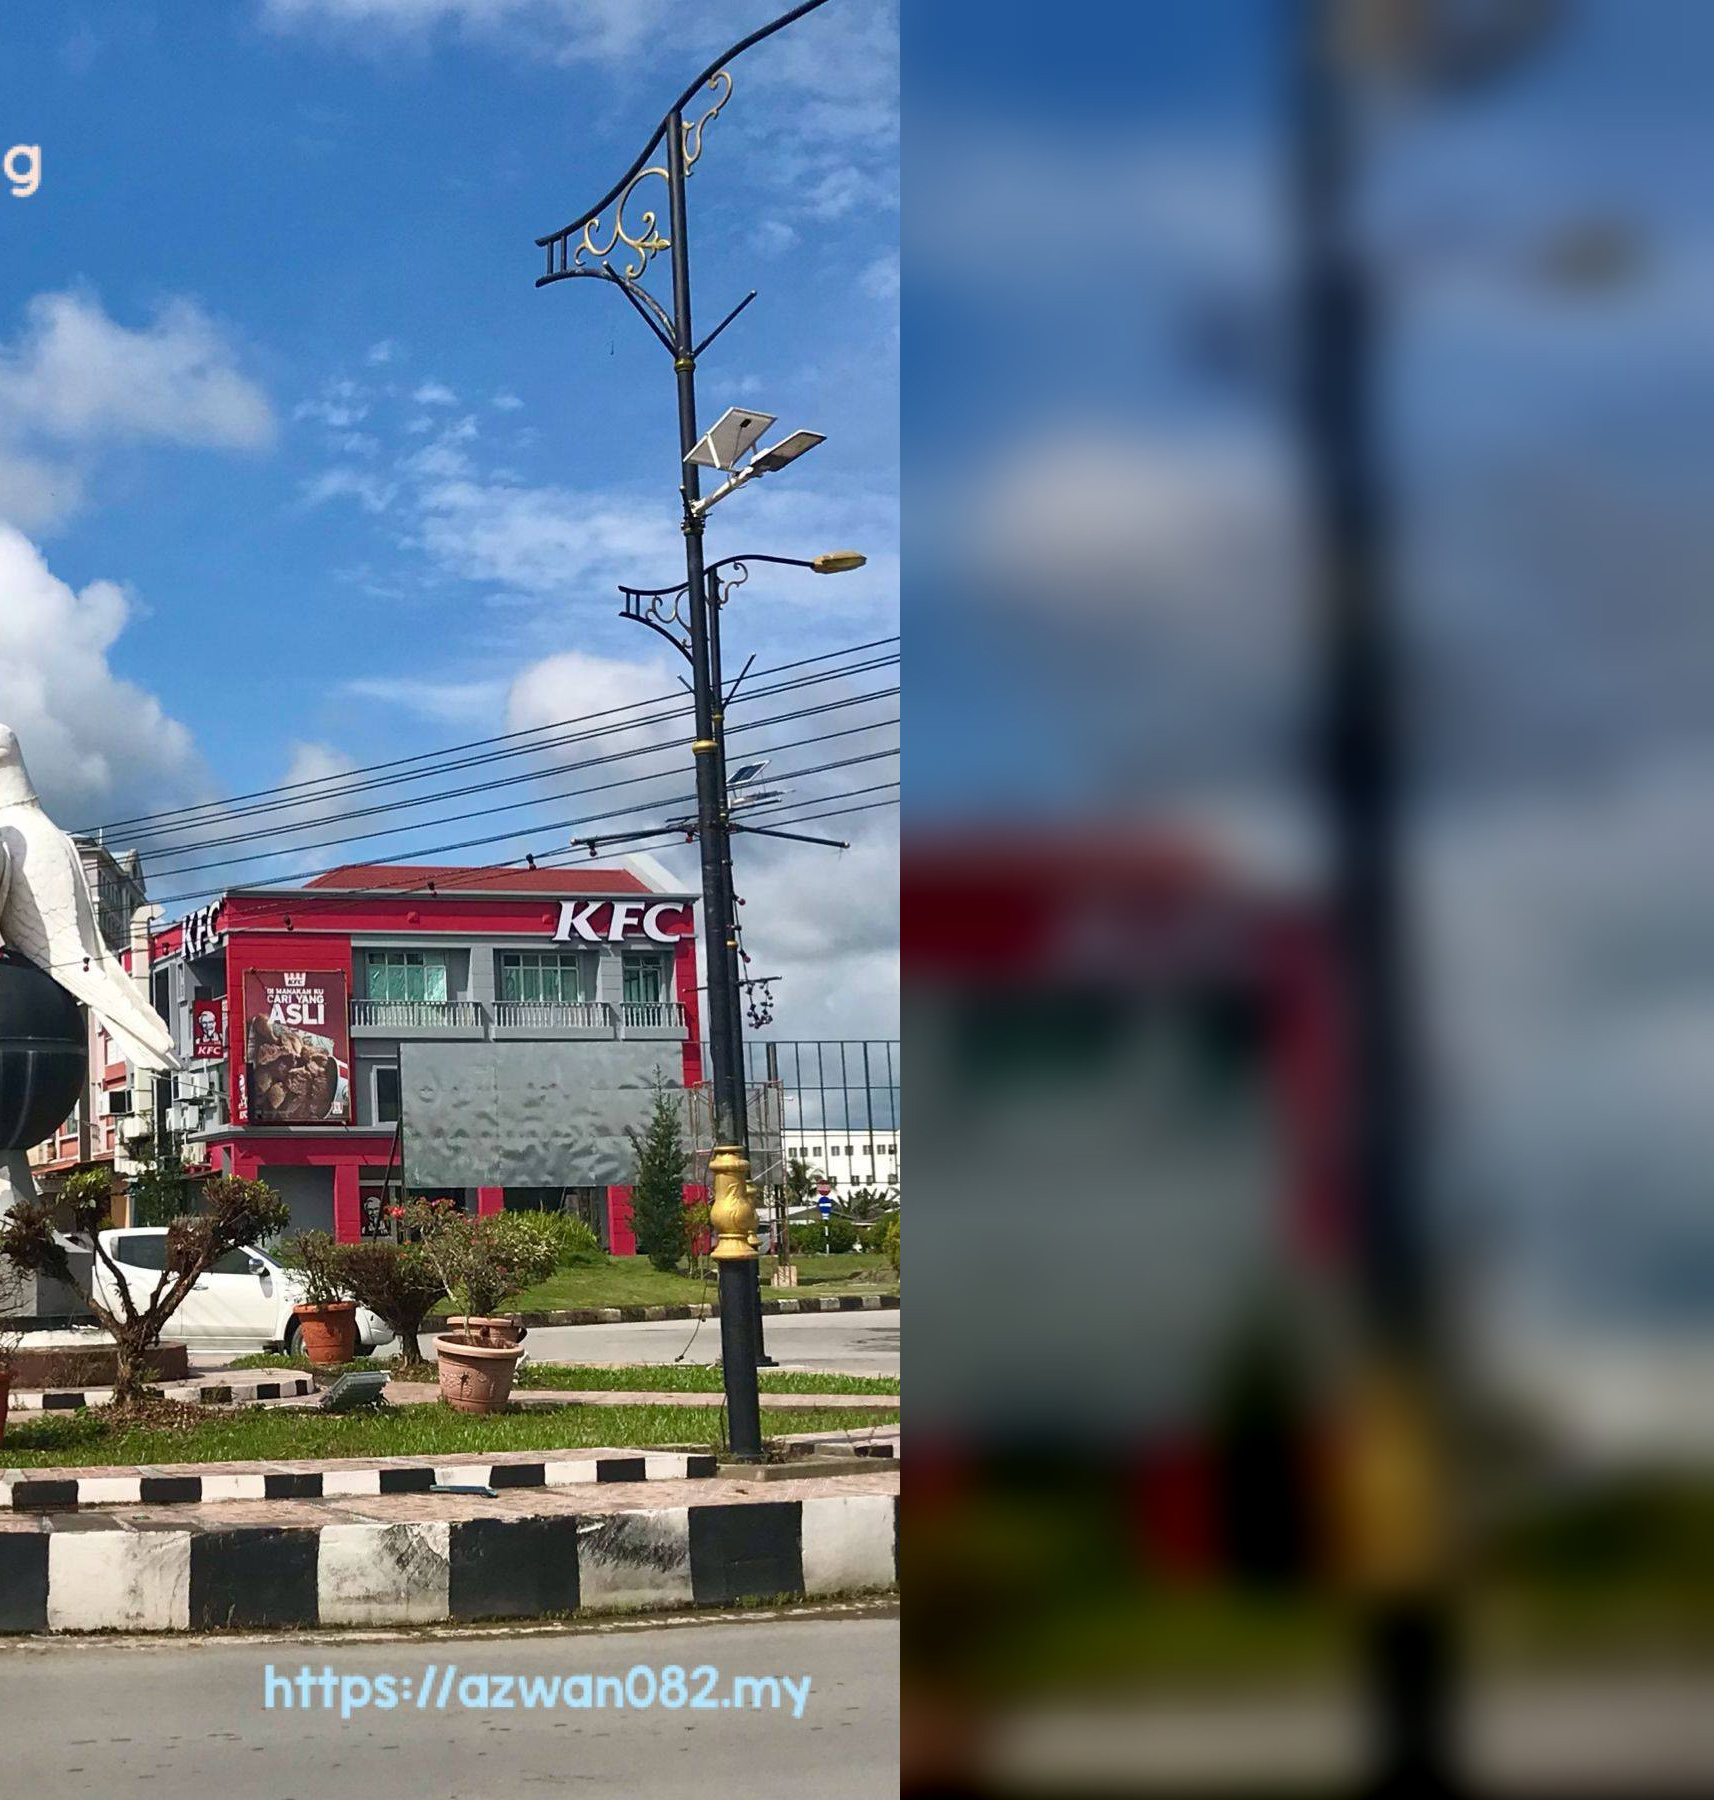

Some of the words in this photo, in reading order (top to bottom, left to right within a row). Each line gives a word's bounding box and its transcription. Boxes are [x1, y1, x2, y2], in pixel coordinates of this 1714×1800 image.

[181, 900, 220, 958] KFC
[551, 900, 685, 943] KFC
[266, 994, 292, 1004] CARI
[295, 994, 325, 1004] YANG
[267, 1003, 325, 1025] ASLI
[197, 1046, 221, 1055] KFC
